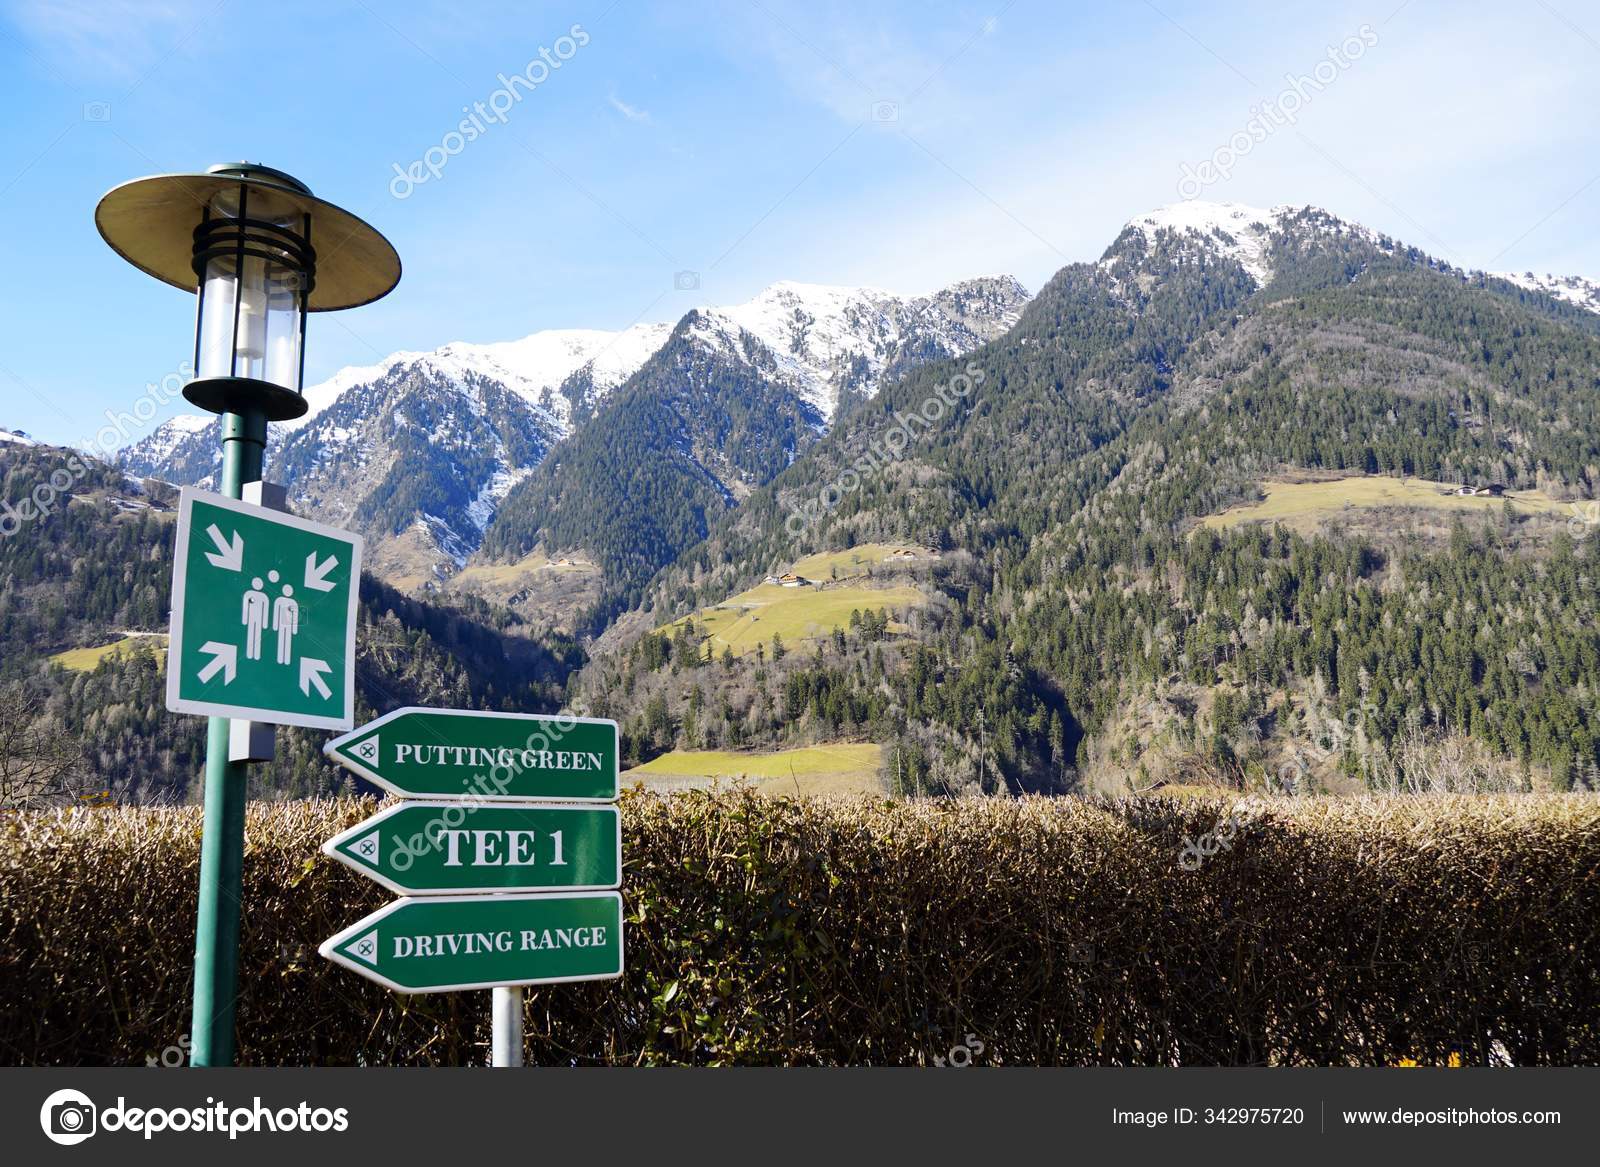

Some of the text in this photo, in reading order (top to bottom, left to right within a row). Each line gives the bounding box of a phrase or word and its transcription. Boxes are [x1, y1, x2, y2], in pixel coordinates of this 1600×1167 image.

[394, 743, 604, 771] PUTTING GREEN
[437, 829, 568, 867] TEE 1
[393, 926, 607, 959] DRIVING RANGE
